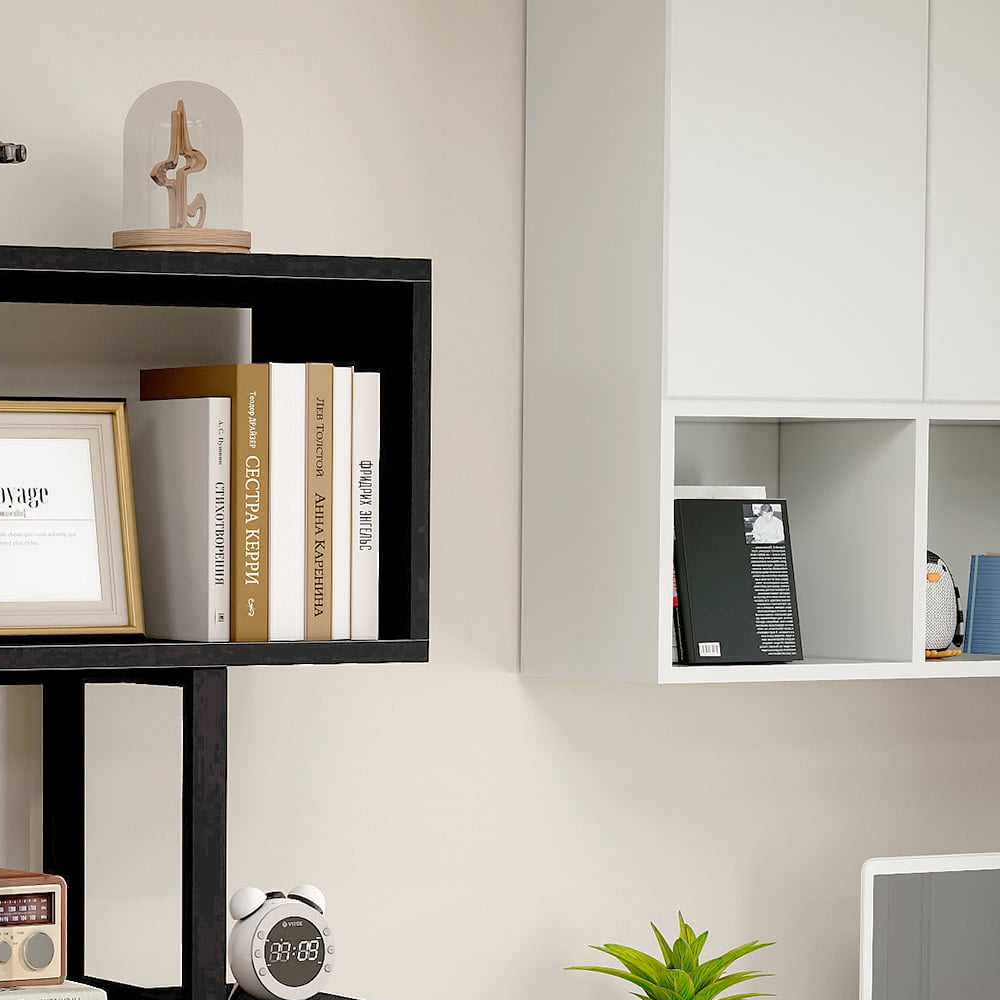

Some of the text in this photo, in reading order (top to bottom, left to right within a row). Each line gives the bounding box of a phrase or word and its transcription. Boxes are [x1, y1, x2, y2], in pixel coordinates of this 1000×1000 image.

[247, 391, 258, 449] Теодор ДРАЙЗЕР
[214, 481, 225, 585] СТИХОТВОРЕНИЯ
[244, 455, 260, 585] СЕСТРА КЕРРИ
[358, 460, 374, 551] ФРИДРИХ ЭНГЕЛЬС
